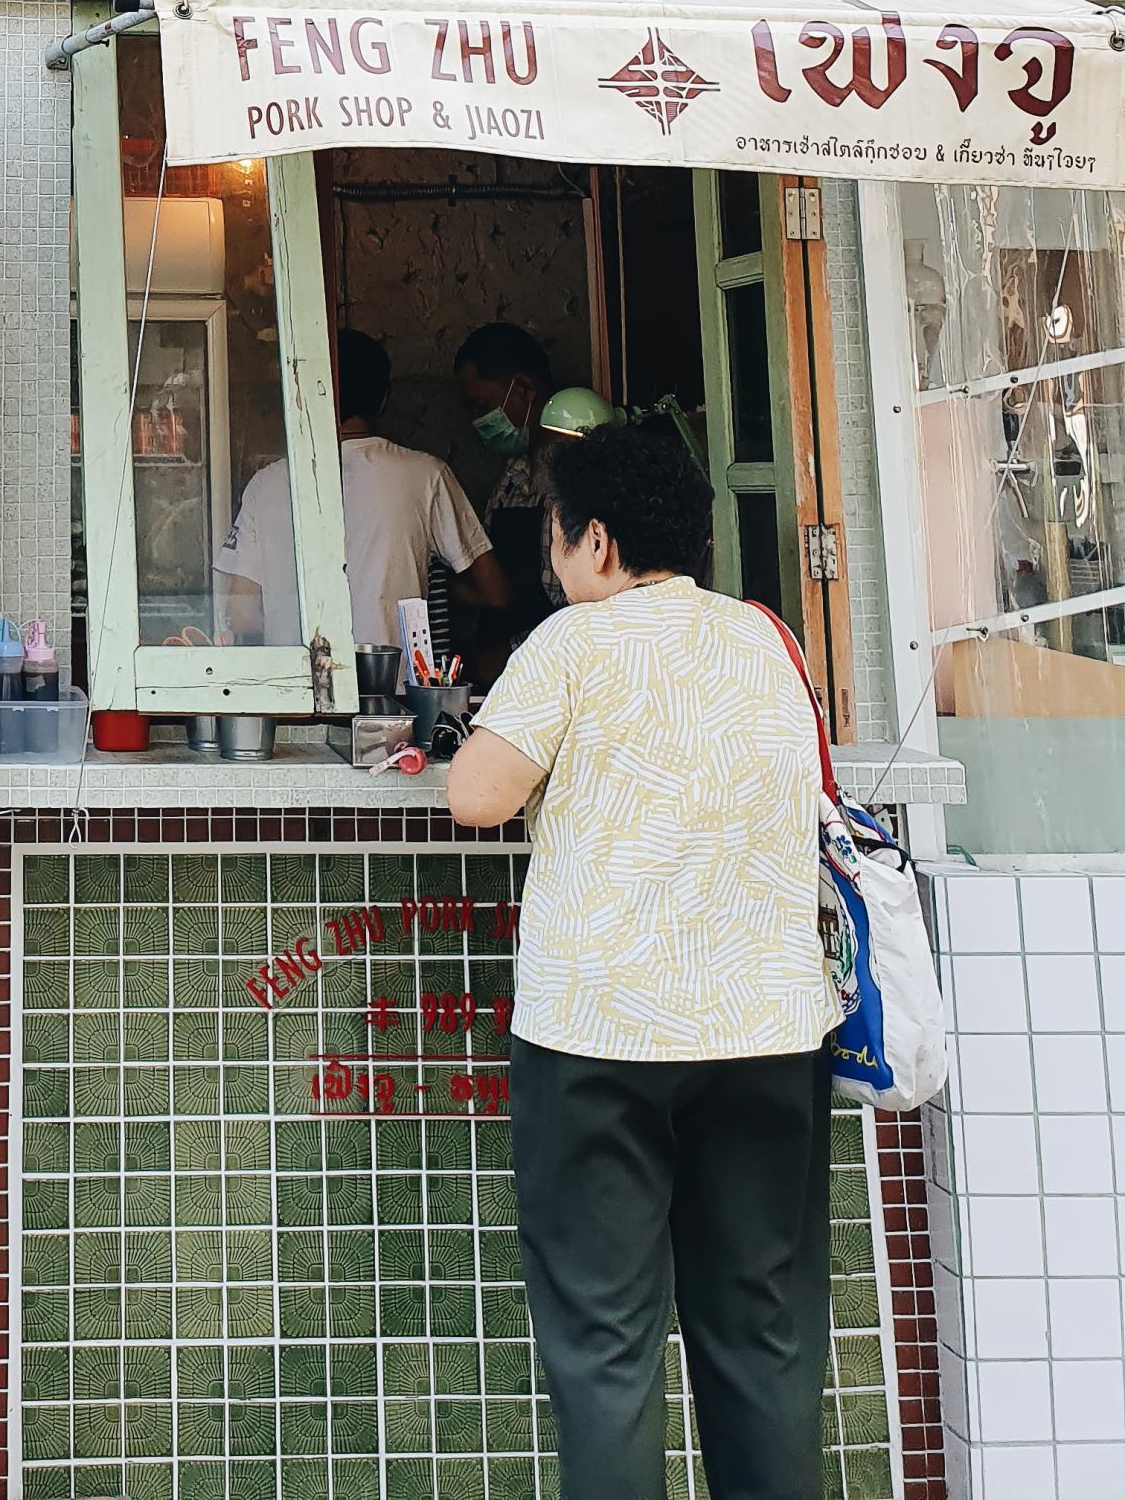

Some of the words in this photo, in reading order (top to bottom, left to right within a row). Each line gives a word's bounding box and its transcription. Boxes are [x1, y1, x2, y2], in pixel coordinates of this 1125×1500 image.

[232, 15, 391, 82] FENG
[424, 18, 537, 86] ZHU
[247, 96, 323, 140] PORK
[338, 96, 413, 127] SHOP
[431, 100, 452, 130] &
[465, 104, 545, 140] JIAOZI
[935, 144, 945, 163] &
[245, 937, 323, 1009] FENG
[325, 904, 385, 956] ZHU
[400, 895, 475, 934] PORK
[420, 992, 475, 1034] 989
